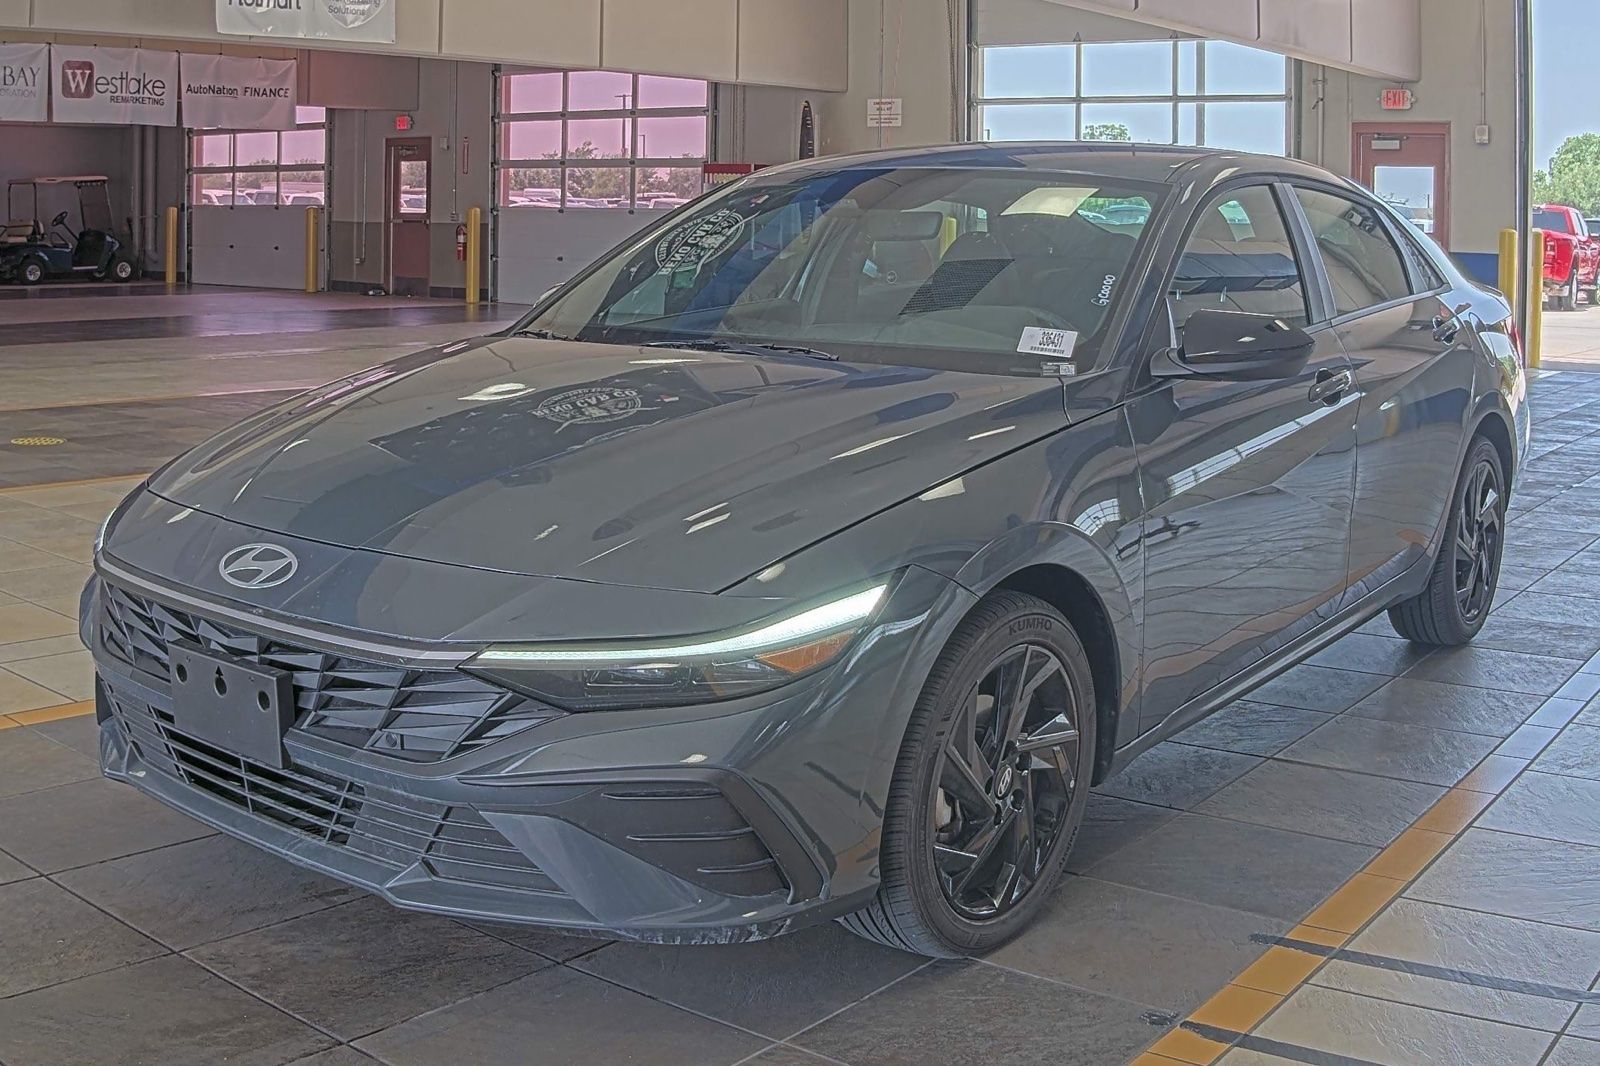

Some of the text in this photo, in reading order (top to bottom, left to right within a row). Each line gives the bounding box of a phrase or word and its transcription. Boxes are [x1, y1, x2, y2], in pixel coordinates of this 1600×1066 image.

[3, 65, 40, 87] BAY
[64, 69, 166, 96] Westlake
[186, 83, 290, 98] AutoNation FINANCE
[110, 95, 165, 106] REMARKETING
[1385, 91, 1406, 107] EXIT
[1009, 618, 1053, 635] KUMHO
